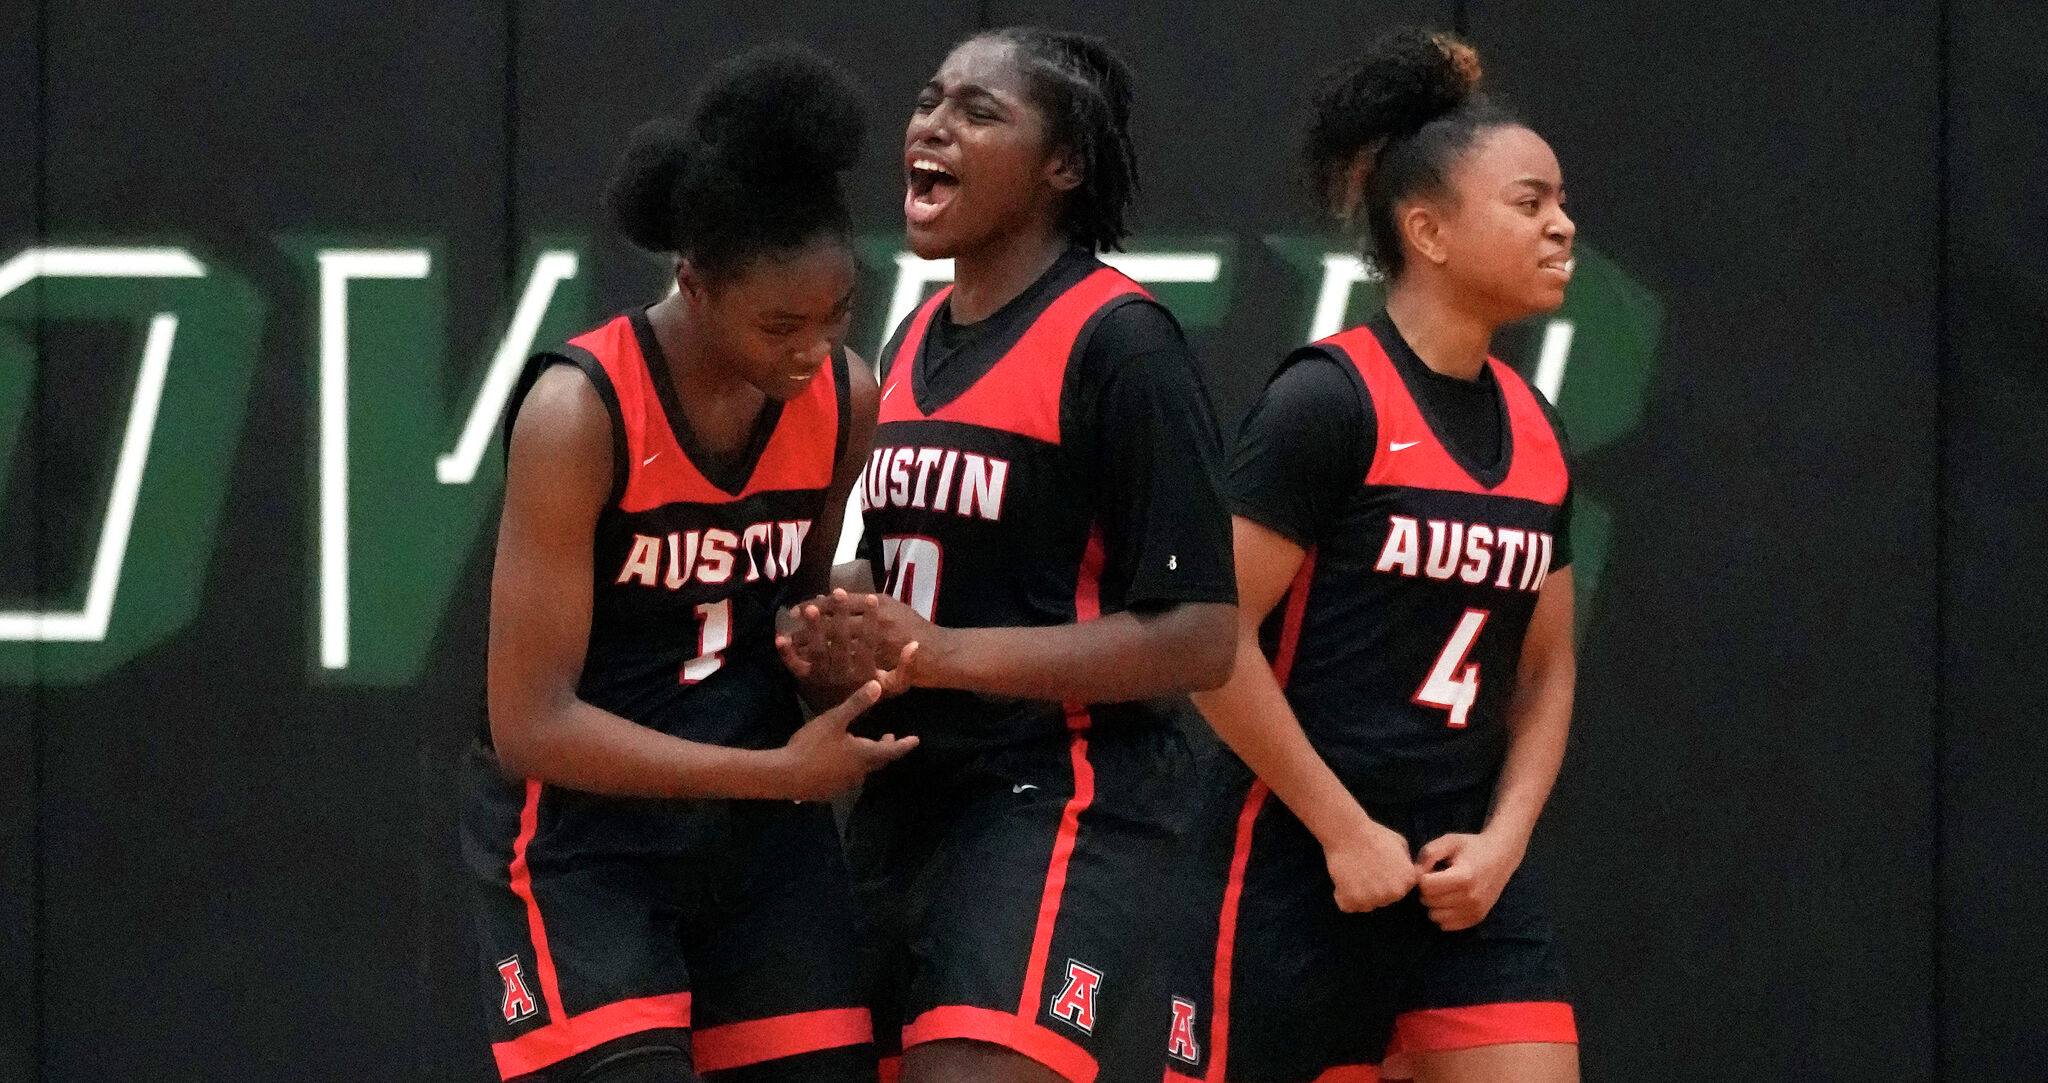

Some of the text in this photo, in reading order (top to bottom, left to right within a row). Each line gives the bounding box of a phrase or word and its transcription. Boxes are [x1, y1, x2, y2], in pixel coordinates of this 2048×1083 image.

[614, 519, 812, 591] AUSTIN
[679, 598, 733, 685] 1
[1411, 606, 1491, 728] 4
[496, 953, 538, 1026] A
[1050, 958, 1104, 1037] A
[1168, 995, 1200, 1066] A
